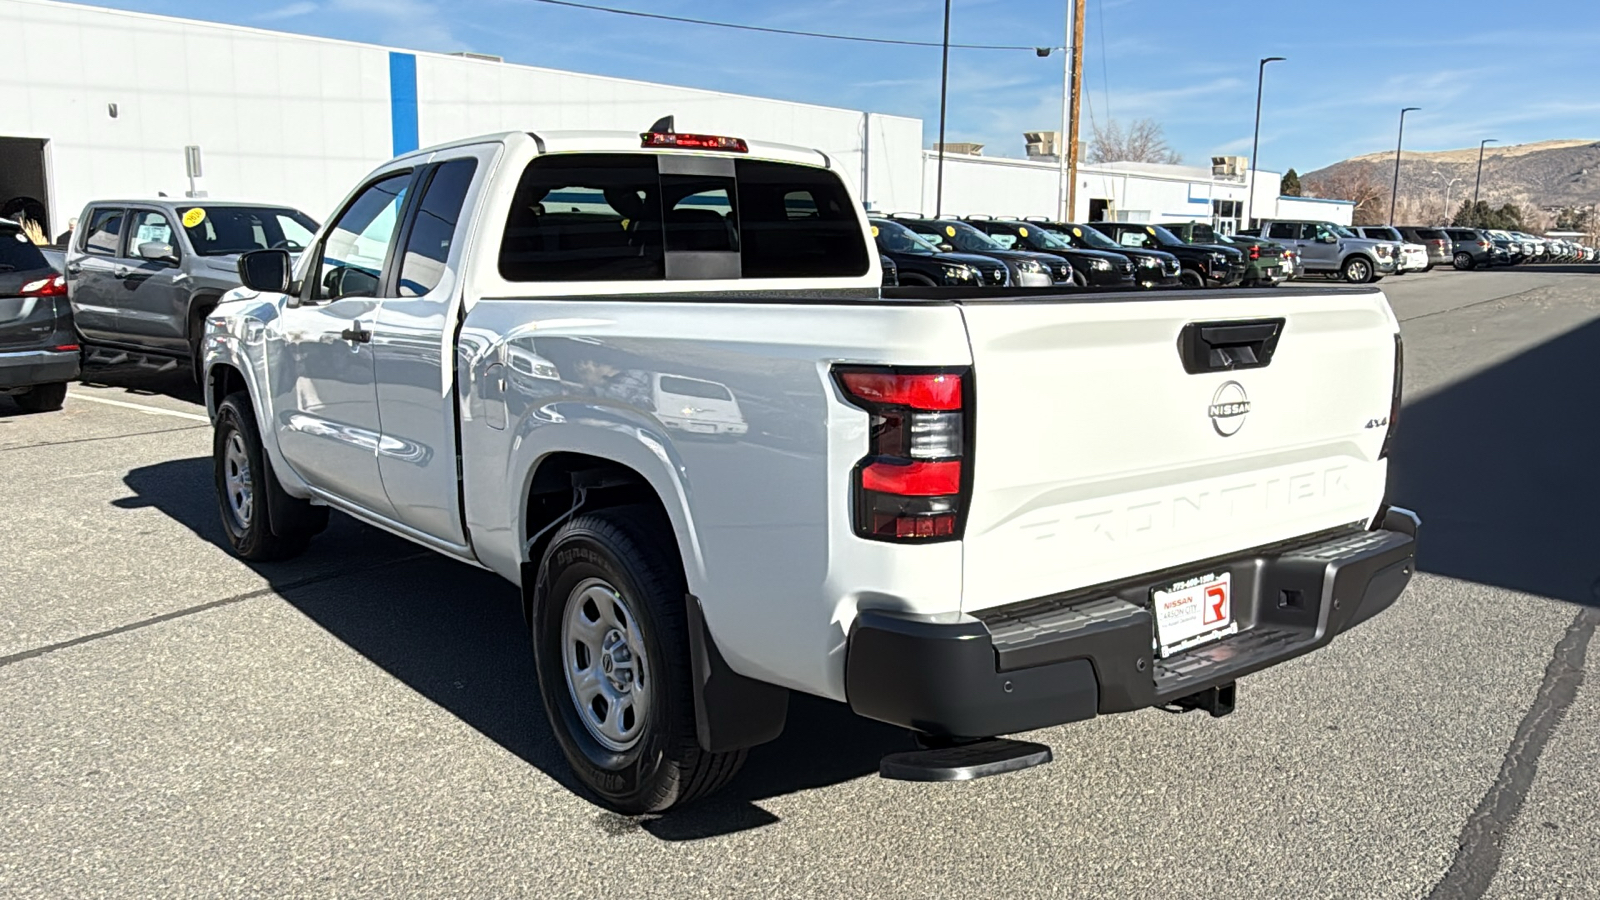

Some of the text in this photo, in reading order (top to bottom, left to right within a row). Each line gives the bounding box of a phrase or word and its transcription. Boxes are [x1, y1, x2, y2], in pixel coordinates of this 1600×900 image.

[1209, 401, 1251, 417] NISSAN
[1018, 465, 1351, 544] FRONTIER
[1163, 596, 1193, 610] NISSAN
[1160, 608, 1185, 620] ARSON
